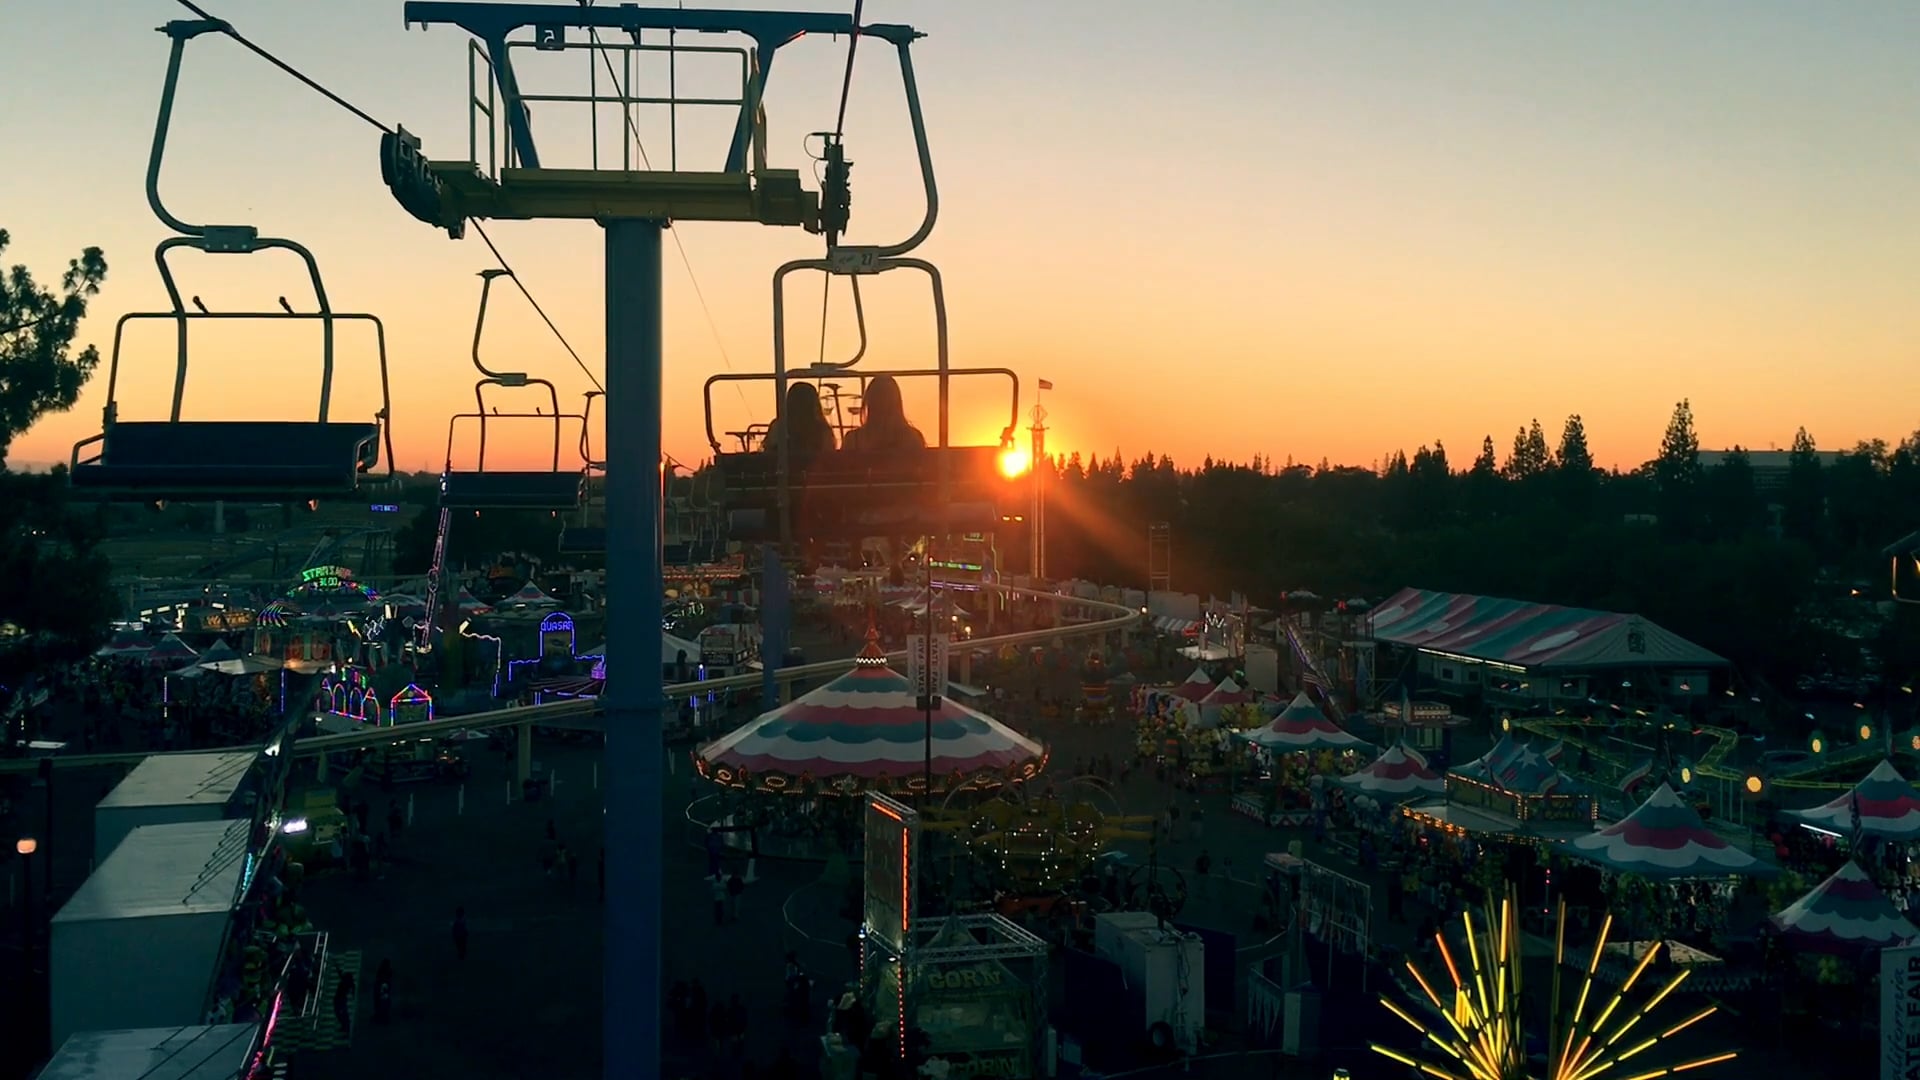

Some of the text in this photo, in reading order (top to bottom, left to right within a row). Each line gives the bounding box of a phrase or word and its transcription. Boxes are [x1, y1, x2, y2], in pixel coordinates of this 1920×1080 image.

[931, 638, 939, 694] STATE FAIR
[927, 966, 1002, 990] CORN
[1886, 968, 1905, 1080] alifornia
[1905, 1034, 1920, 1080] ATE
